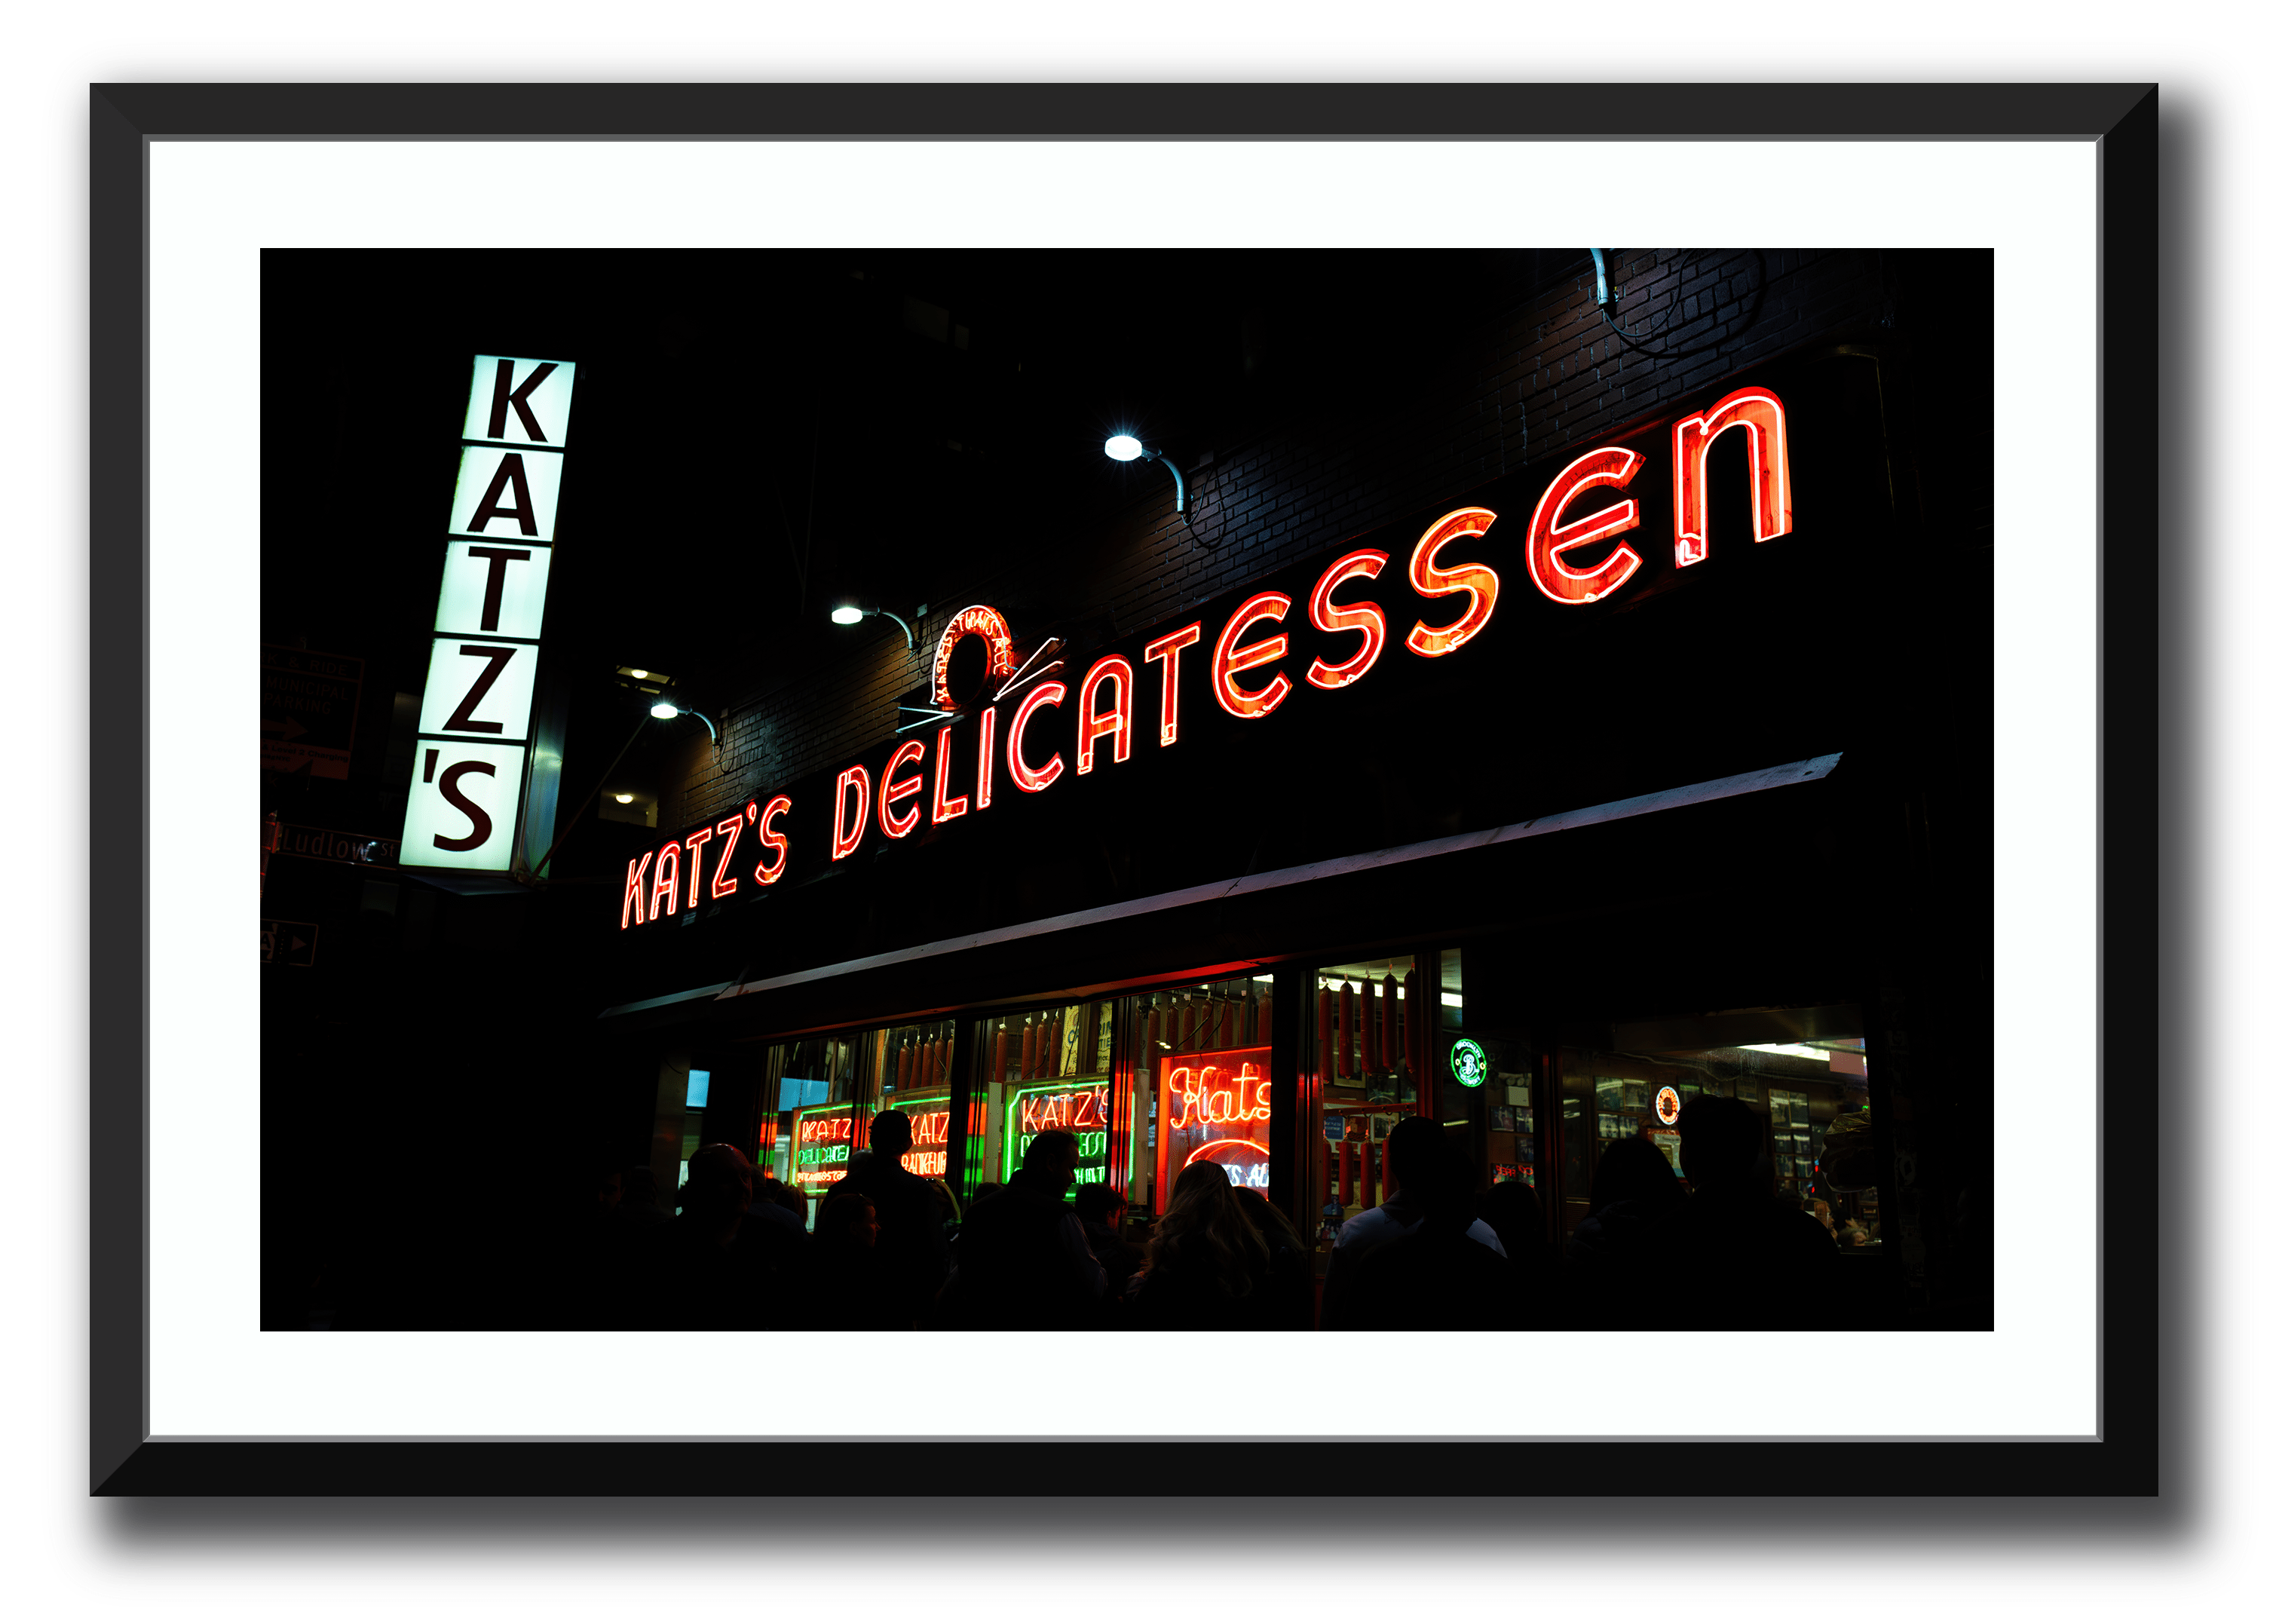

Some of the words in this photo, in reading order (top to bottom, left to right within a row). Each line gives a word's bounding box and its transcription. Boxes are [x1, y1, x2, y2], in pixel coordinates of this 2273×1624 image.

[423, 358, 559, 852] KATZ'S
[260, 651, 279, 665] RK
[289, 657, 300, 668] &
[310, 660, 348, 676] RIDE
[266, 676, 349, 701] MUNICIPAL
[263, 693, 332, 715] PARKING
[271, 745, 297, 755] Level
[308, 750, 349, 763] Charging
[282, 828, 378, 862] Ludlow
[381, 842, 395, 858] St
[620, 794, 792, 930] KATZ'S
[801, 1117, 852, 1142] KATZ
[910, 1111, 950, 1144] KATZ
